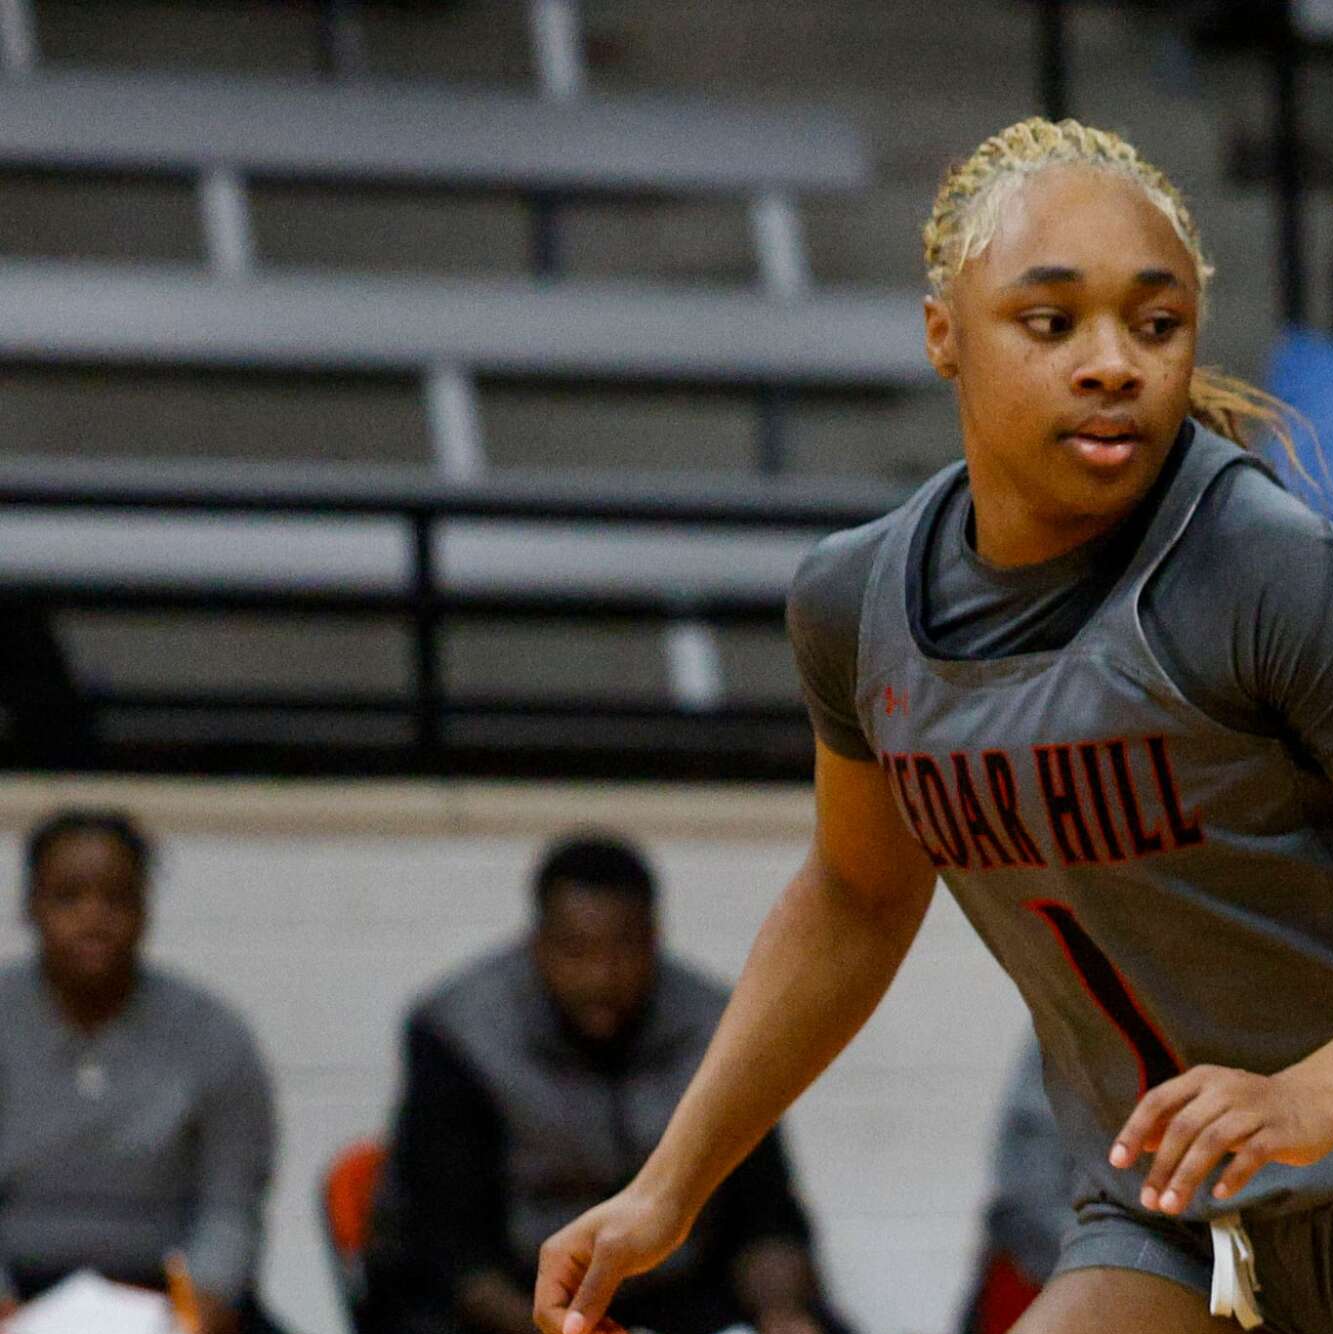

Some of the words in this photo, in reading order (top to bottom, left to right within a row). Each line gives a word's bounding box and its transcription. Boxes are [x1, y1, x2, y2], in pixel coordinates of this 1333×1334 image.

[881, 750, 1048, 872] EDAR
[1031, 732, 1205, 868] HILL
[1018, 899, 1190, 1101] 1
